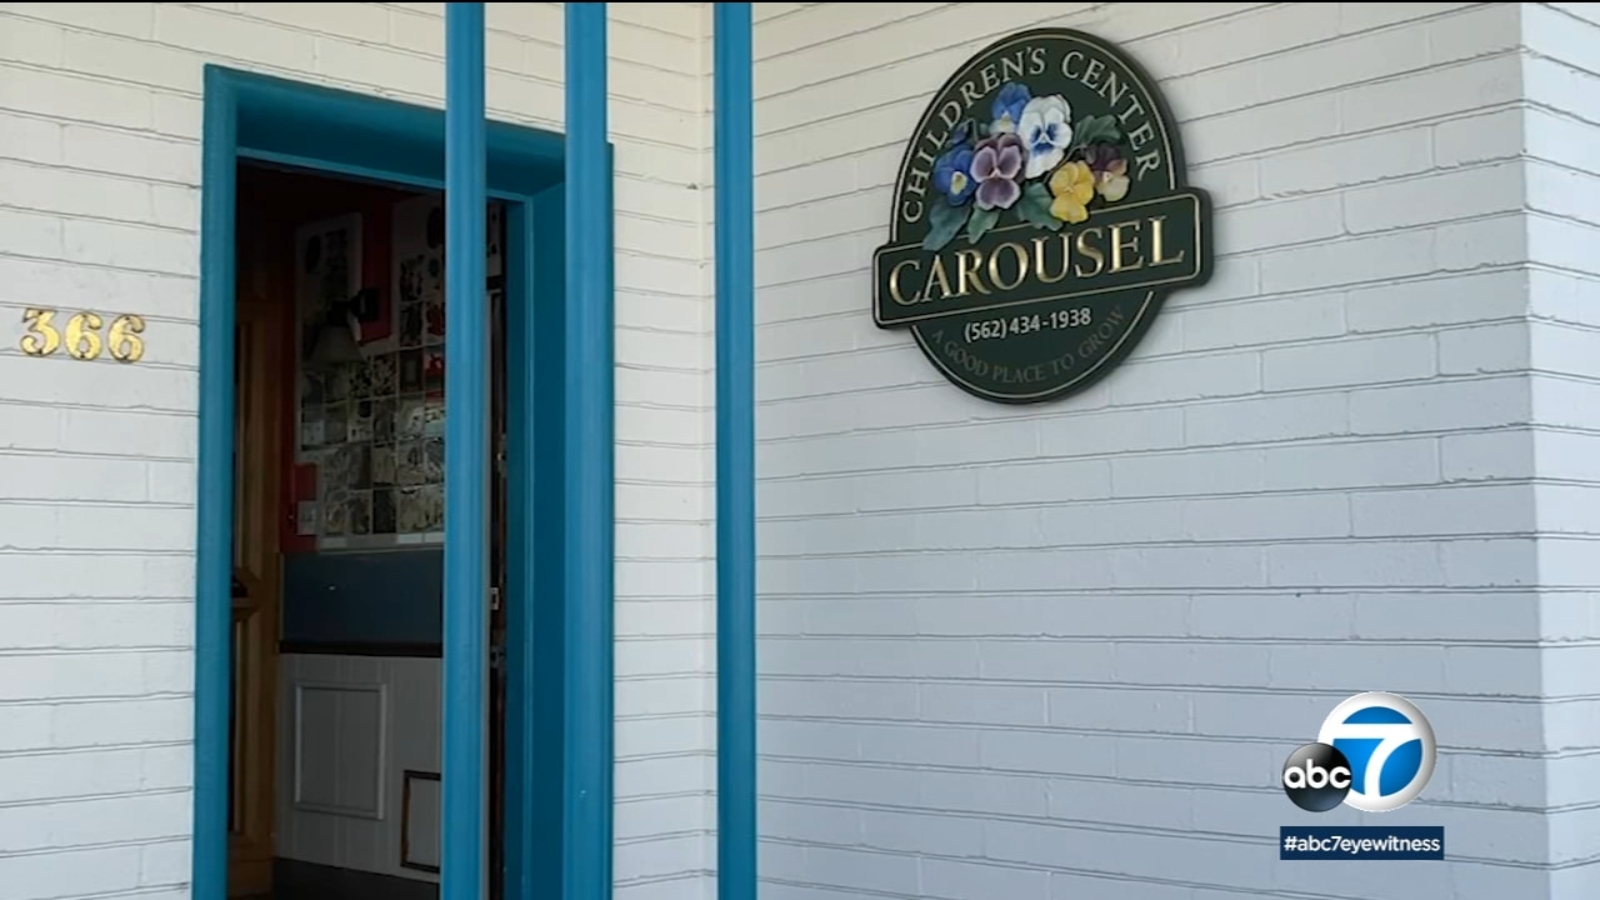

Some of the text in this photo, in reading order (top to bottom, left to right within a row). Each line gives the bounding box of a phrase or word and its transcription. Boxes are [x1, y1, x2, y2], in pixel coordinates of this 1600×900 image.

[902, 46, 1161, 223] CHILDREN'S CENTER
[889, 215, 1185, 305] CAROUSEL
[20, 307, 146, 363] 366
[944, 339, 989, 377] GOOD
[992, 363, 1046, 383] PLACE
[1052, 352, 1075, 376] TO
[1078, 305, 1126, 359] GROW
